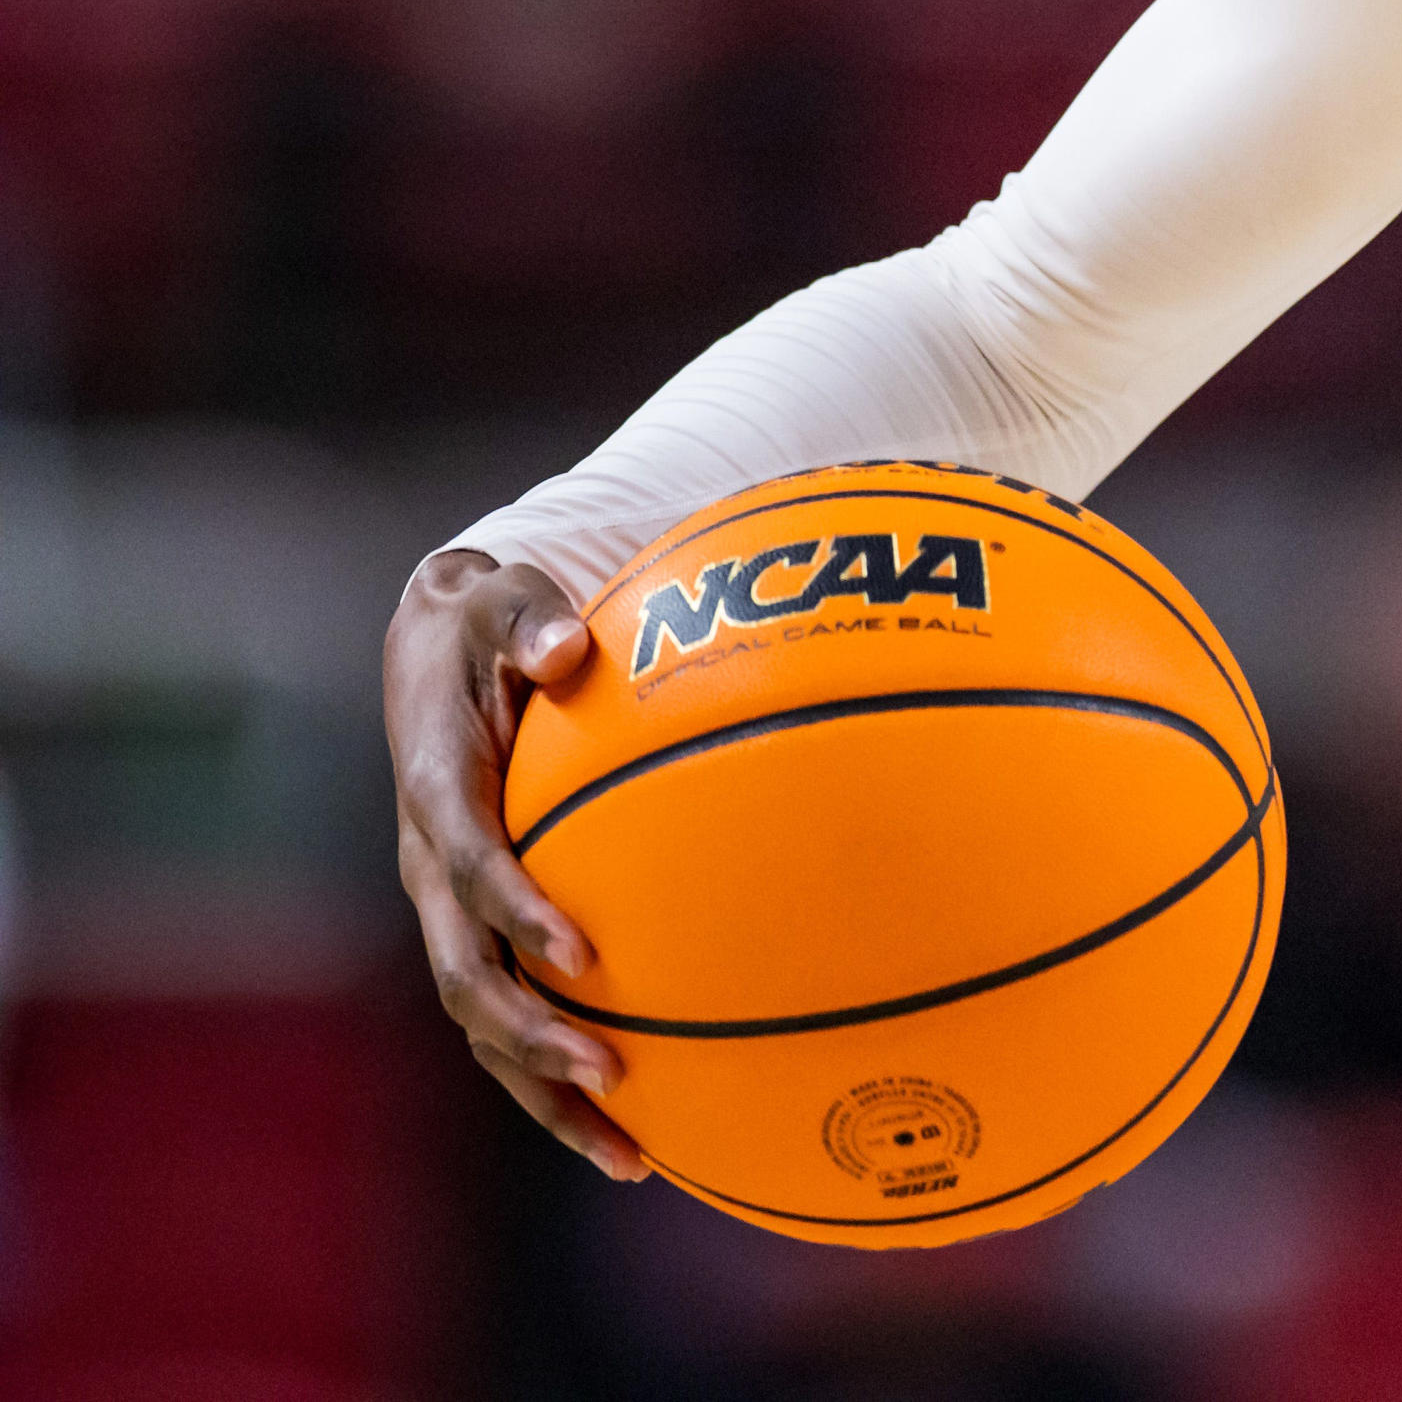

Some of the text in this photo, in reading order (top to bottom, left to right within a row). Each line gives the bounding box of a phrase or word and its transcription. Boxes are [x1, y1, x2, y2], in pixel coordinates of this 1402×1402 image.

[629, 532, 991, 682] NCAA
[635, 617, 993, 702] OFFICIAL GAME BALL
